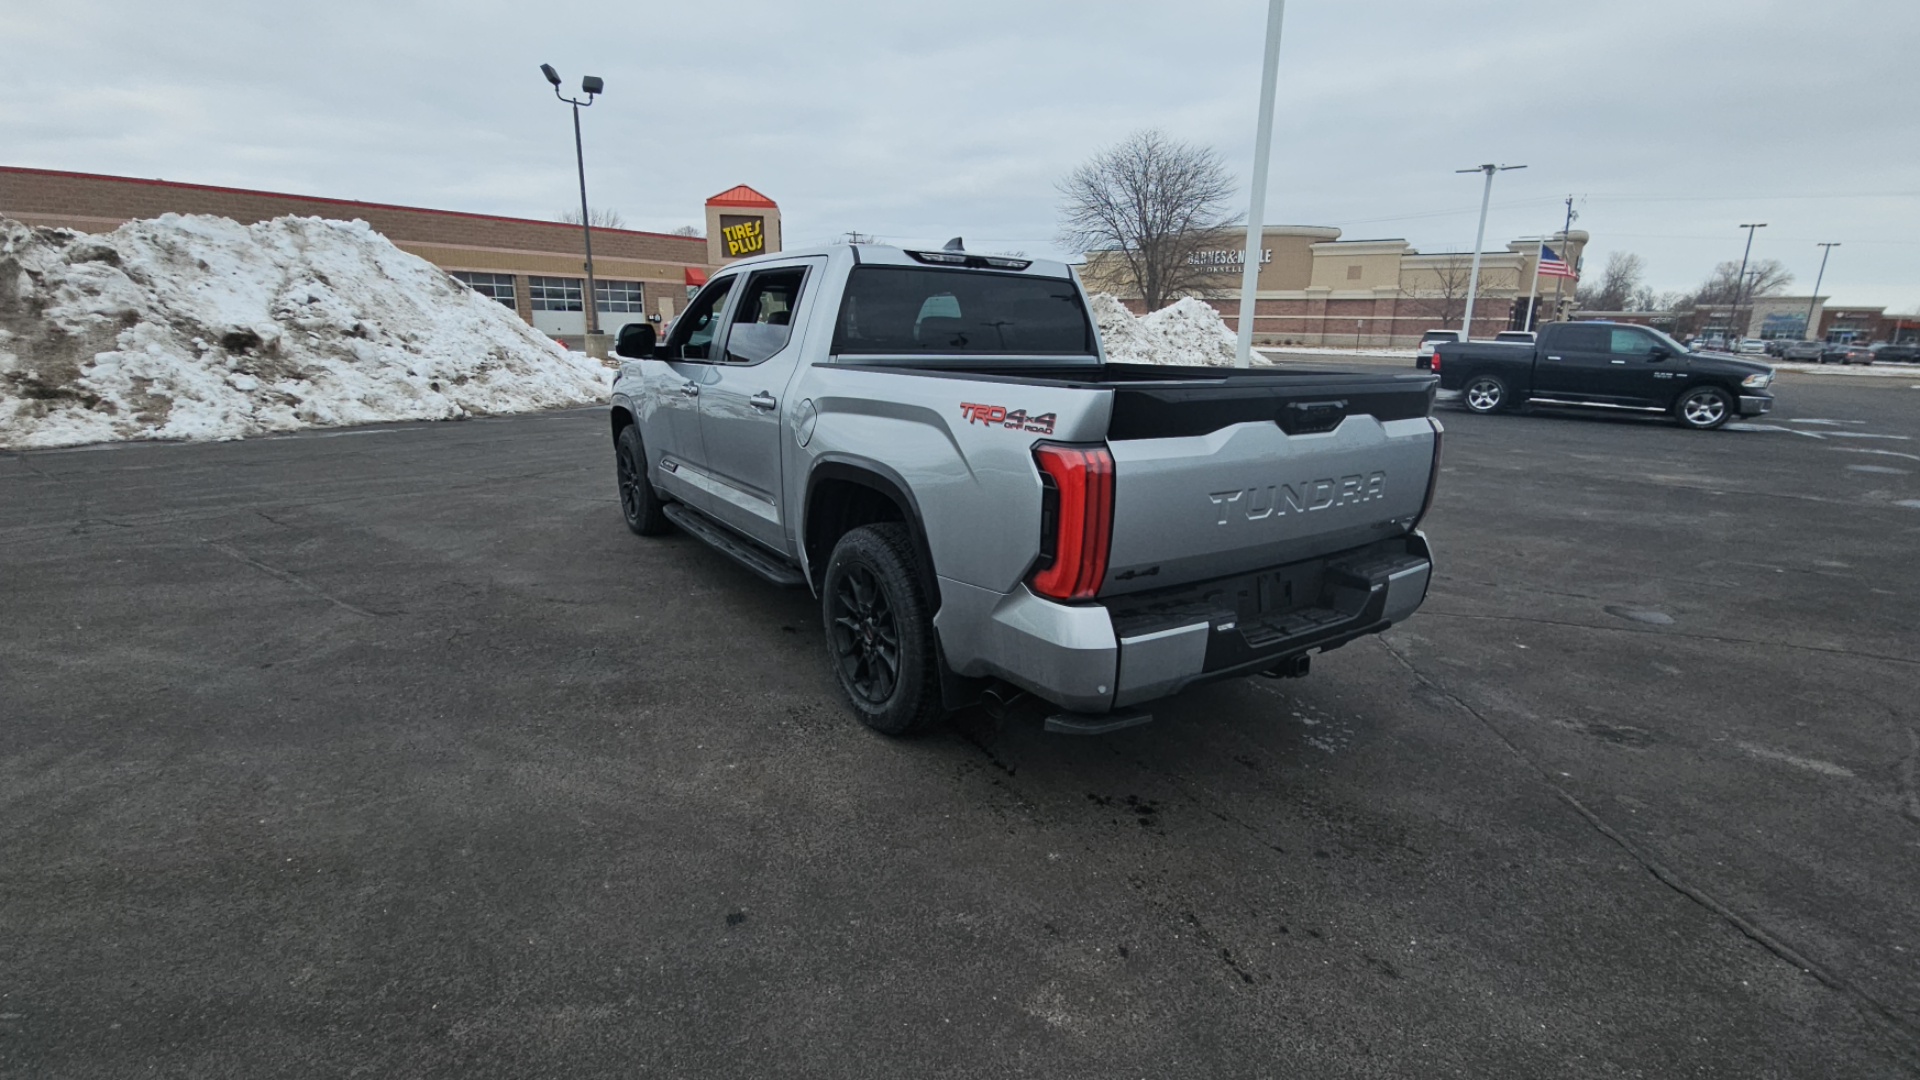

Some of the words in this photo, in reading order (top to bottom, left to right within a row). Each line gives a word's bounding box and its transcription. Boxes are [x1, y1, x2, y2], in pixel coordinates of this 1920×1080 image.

[722, 220, 761, 242] TIRES
[728, 234, 763, 256] PLUS
[960, 402, 1007, 427] TRD
[1004, 421, 1023, 430] OFF
[1024, 424, 1053, 435] ROAD
[1208, 470, 1386, 525] TUNDRA
